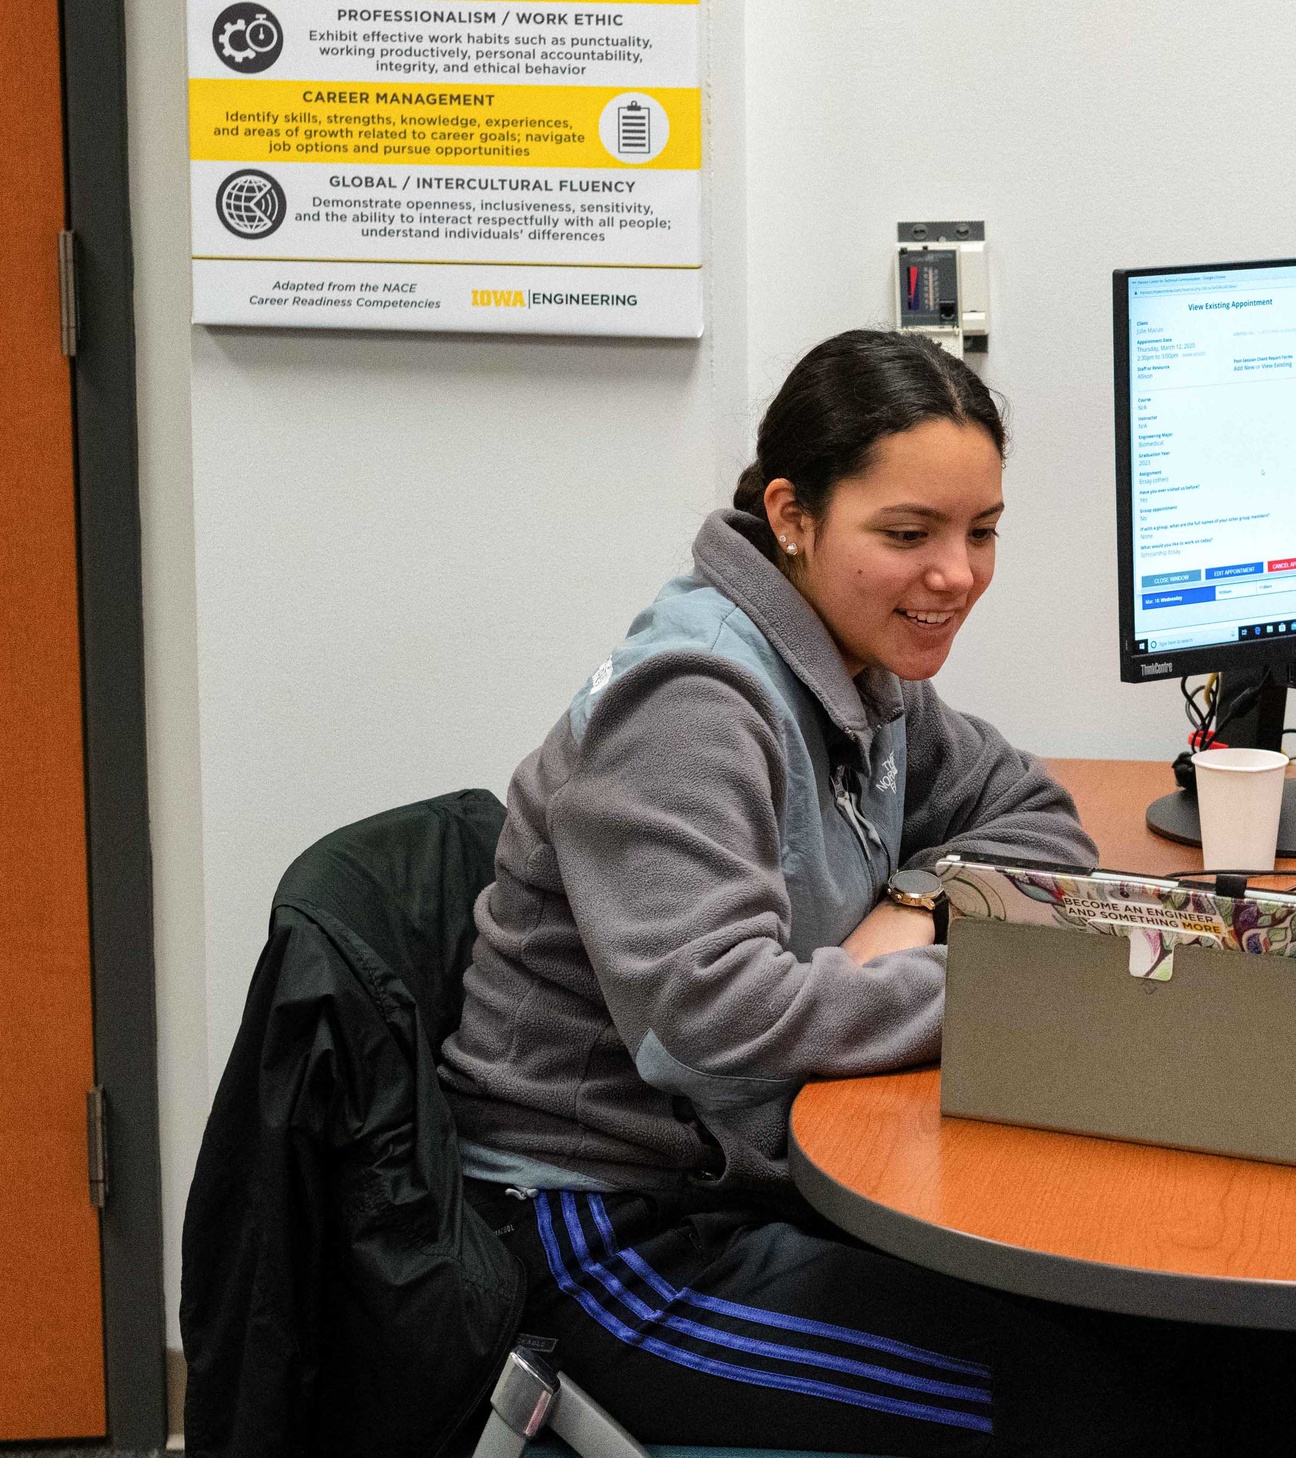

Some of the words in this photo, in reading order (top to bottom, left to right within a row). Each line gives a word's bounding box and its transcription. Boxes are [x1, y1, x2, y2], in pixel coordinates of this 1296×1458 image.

[337, 9, 495, 23] PROFESSIONALISM
[515, 12, 567, 25] WORK
[574, 13, 622, 26] ETHIC
[309, 30, 357, 41] Exhibit
[362, 30, 423, 43] effective
[428, 32, 462, 43] work
[467, 32, 509, 44] habits
[514, 34, 546, 45] such
[551, 37, 565, 45] as
[570, 36, 652, 49] punctuality,
[319, 44, 375, 58] working
[380, 46, 470, 60] productively,
[475, 48, 535, 60] personal
[540, 49, 642, 63] accountability,
[376, 60, 438, 74] integrity,
[442, 61, 468, 72] and
[473, 62, 520, 73] ethical
[525, 62, 586, 75] behavior
[302, 90, 369, 103] CAREER
[376, 92, 494, 106] MANAGEMENT
[225, 110, 278, 124] Identify
[284, 112, 321, 124] skills,
[326, 113, 395, 126] strengths,
[400, 114, 480, 128] knowledge,
[485, 116, 572, 129] experiences,
[213, 125, 238, 136] and
[243, 128, 280, 137] areas
[285, 126, 299, 137] of
[304, 127, 353, 139] growth
[358, 128, 406, 139] related
[411, 129, 426, 140] to
[430, 131, 474, 140] career
[479, 130, 520, 142] goals;
[525, 132, 584, 144] navigate
[268, 140, 291, 153] job
[295, 141, 348, 154] options
[353, 142, 378, 153] and
[383, 145, 430, 155] pursue
[435, 144, 530, 156] opportunities
[329, 175, 397, 188] GLOBAL
[416, 177, 553, 191] INTERCULTURAL
[559, 180, 635, 192] FLUENCY
[312, 196, 401, 208] Demonstrate
[406, 200, 475, 211] openness,
[480, 199, 575, 213] inclusiveness,
[580, 202, 653, 215] sensitivity,
[294, 210, 320, 221] and
[325, 211, 347, 222] the
[352, 211, 395, 225] ability
[400, 213, 414, 223] to
[419, 212, 472, 224] interact
[477, 214, 559, 228] respectfully
[564, 215, 593, 226] with
[598, 216, 614, 227] all
[619, 217, 670, 230] people;
[361, 226, 439, 238] understand
[444, 227, 523, 239] individuals'
[528, 229, 605, 241] differences
[272, 280, 324, 292] Adapted
[327, 281, 355, 291] from
[359, 282, 378, 292] the
[382, 283, 417, 292] NACE
[249, 295, 289, 305] Career
[292, 296, 352, 306] Readiness
[356, 297, 440, 309] Competencies
[471, 289, 526, 307] IOWA
[532, 293, 638, 306] ENGINEERING
[1205, 301, 1230, 310] Existing
[1231, 299, 1273, 309] Appointment
[1138, 440, 1164, 448] Biomedical
[1225, 566, 1255, 576] APPOINTMENT
[1272, 562, 1289, 570] CANCEL
[1169, 574, 1189, 582] WINDOW
[1160, 595, 1183, 603] Wednesday
[1141, 662, 1172, 676] ThinkCentre
[1064, 897, 1120, 911] BECOME
[1124, 905, 1143, 914] AN
[1069, 908, 1096, 917] AND
[1100, 911, 1179, 928] SOMETHING
[1182, 922, 1221, 934] MORE
